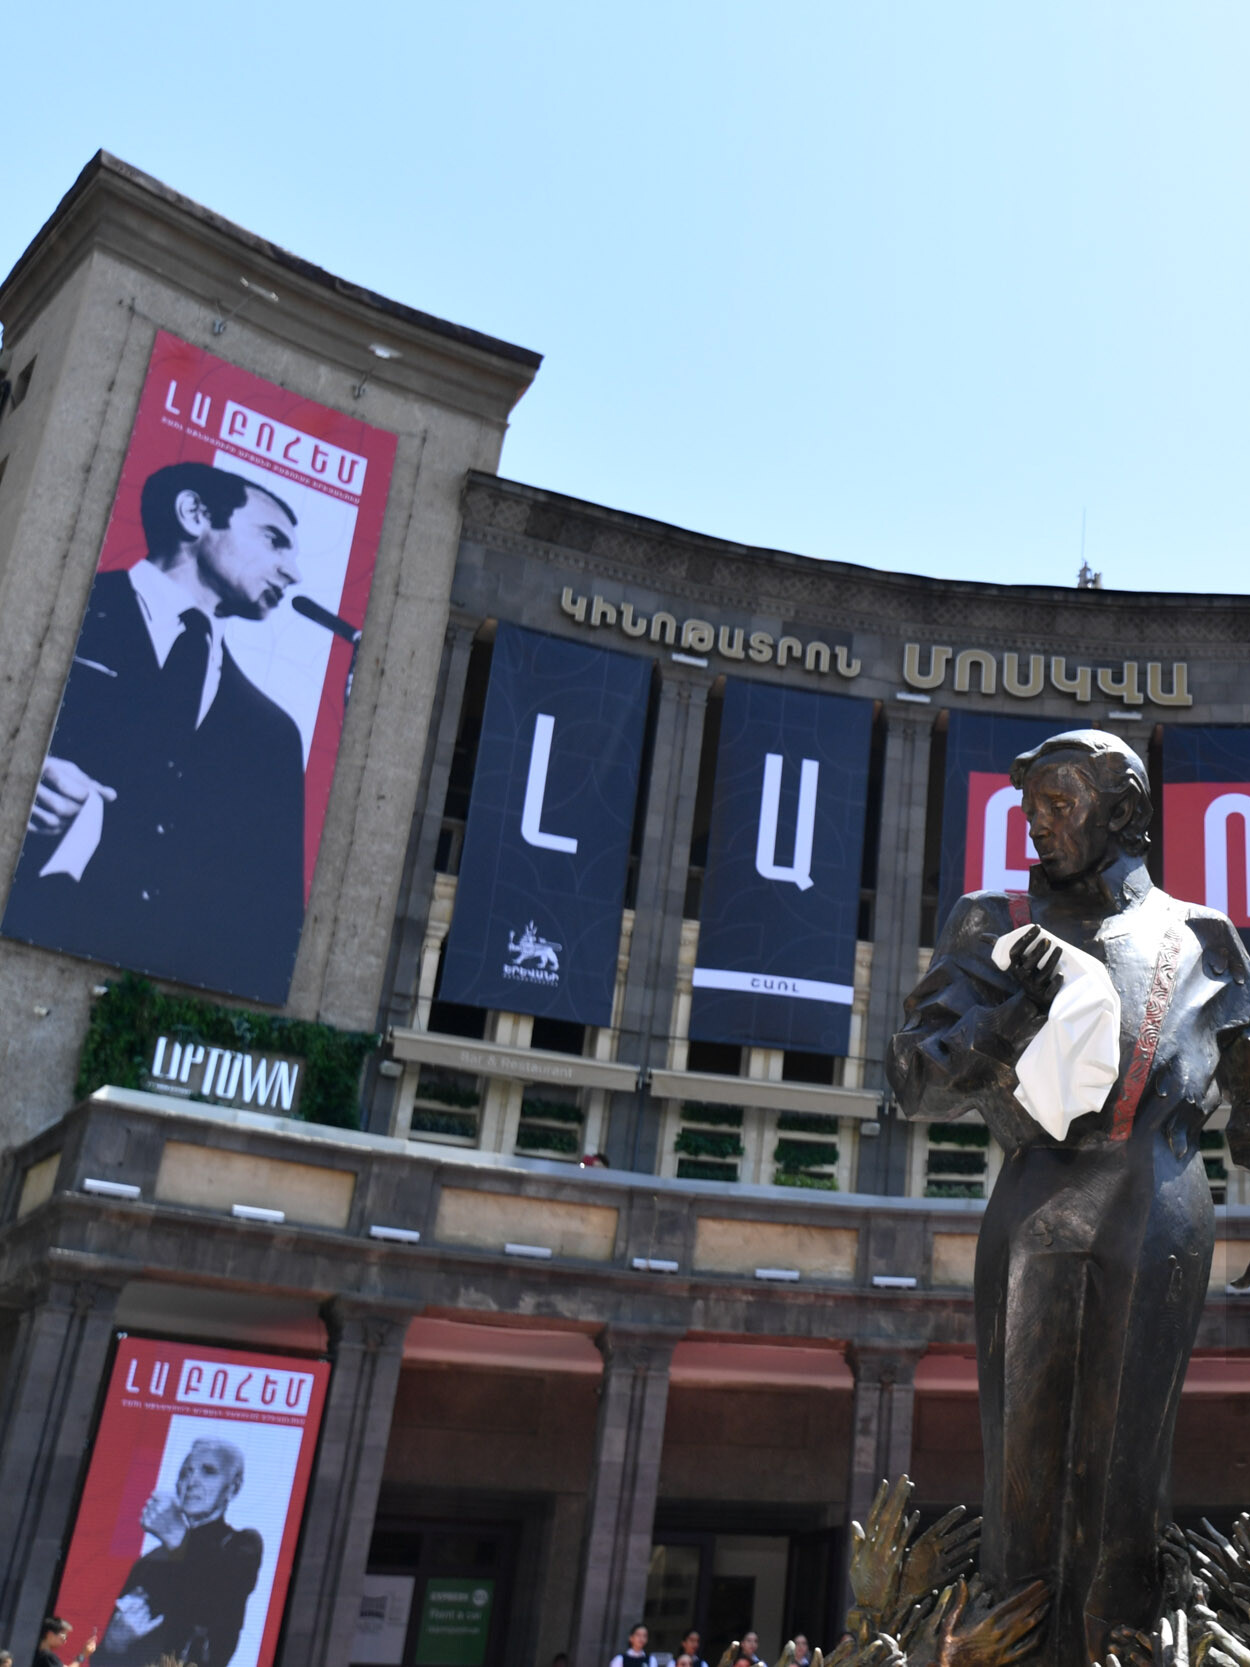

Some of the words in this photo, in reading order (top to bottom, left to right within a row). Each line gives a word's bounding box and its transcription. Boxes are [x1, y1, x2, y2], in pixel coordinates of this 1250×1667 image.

[165, 379, 212, 428] ԼԱ
[903, 643, 1193, 706] ՄՈՍԿՎԱ
[152, 1036, 299, 1110] UPTOWN
